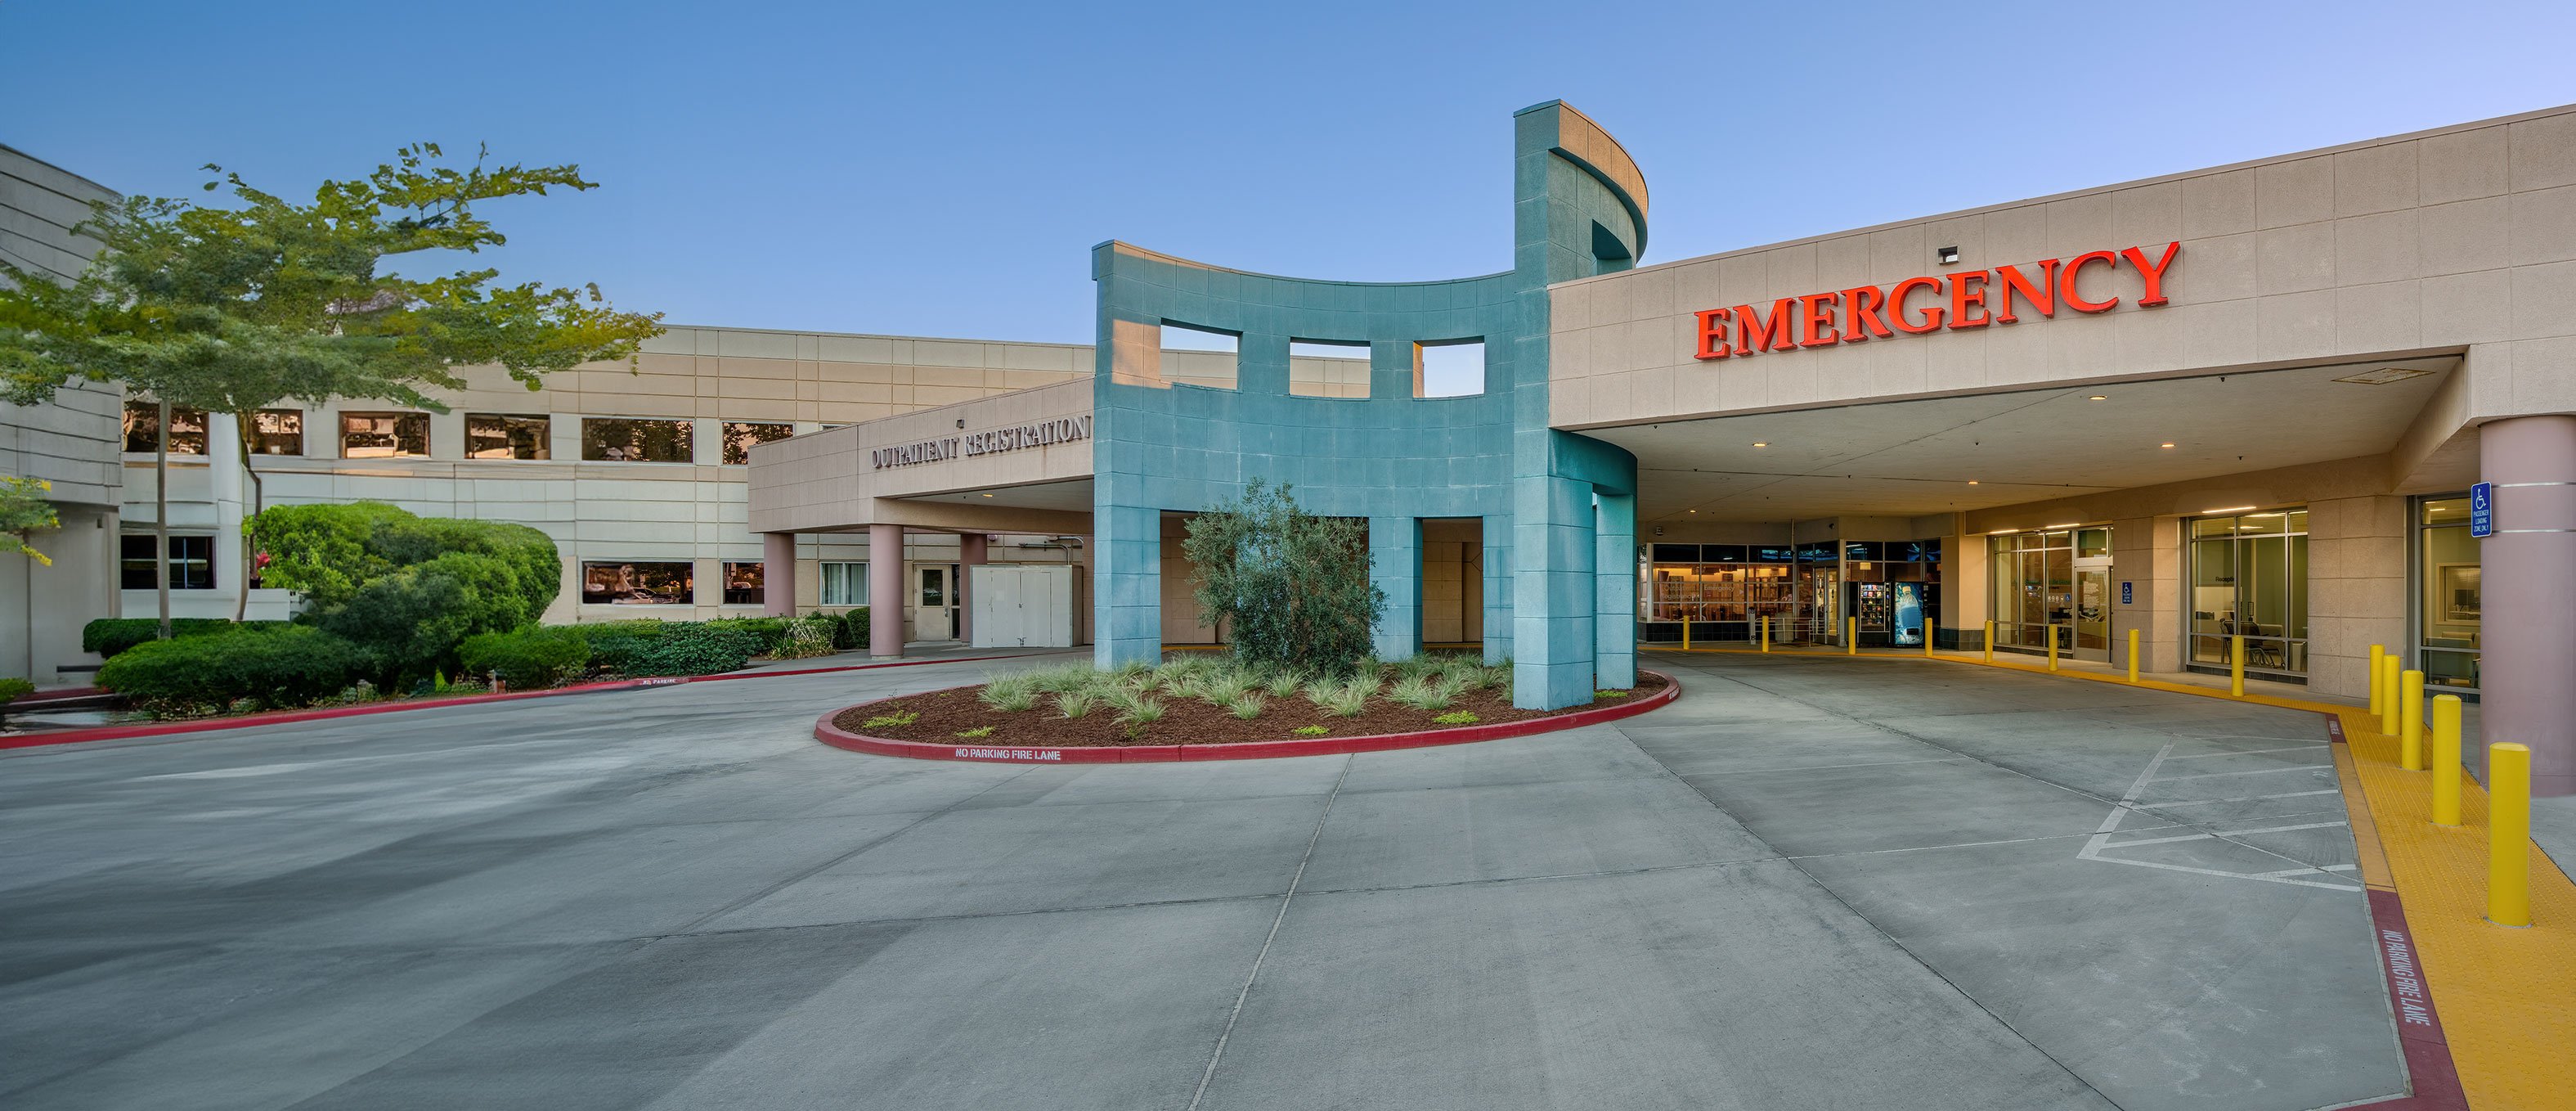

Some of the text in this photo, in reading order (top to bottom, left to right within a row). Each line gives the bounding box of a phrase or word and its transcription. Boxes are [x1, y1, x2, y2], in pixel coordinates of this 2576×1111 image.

[1694, 241, 2180, 360] EMERGENCY
[871, 415, 1092, 469] OUTPATIENT REGISTRATION
[955, 748, 1061, 761] NO PARKING FIRE LANE
[2382, 929, 2430, 1026] NO PARKING FIRE LANE
